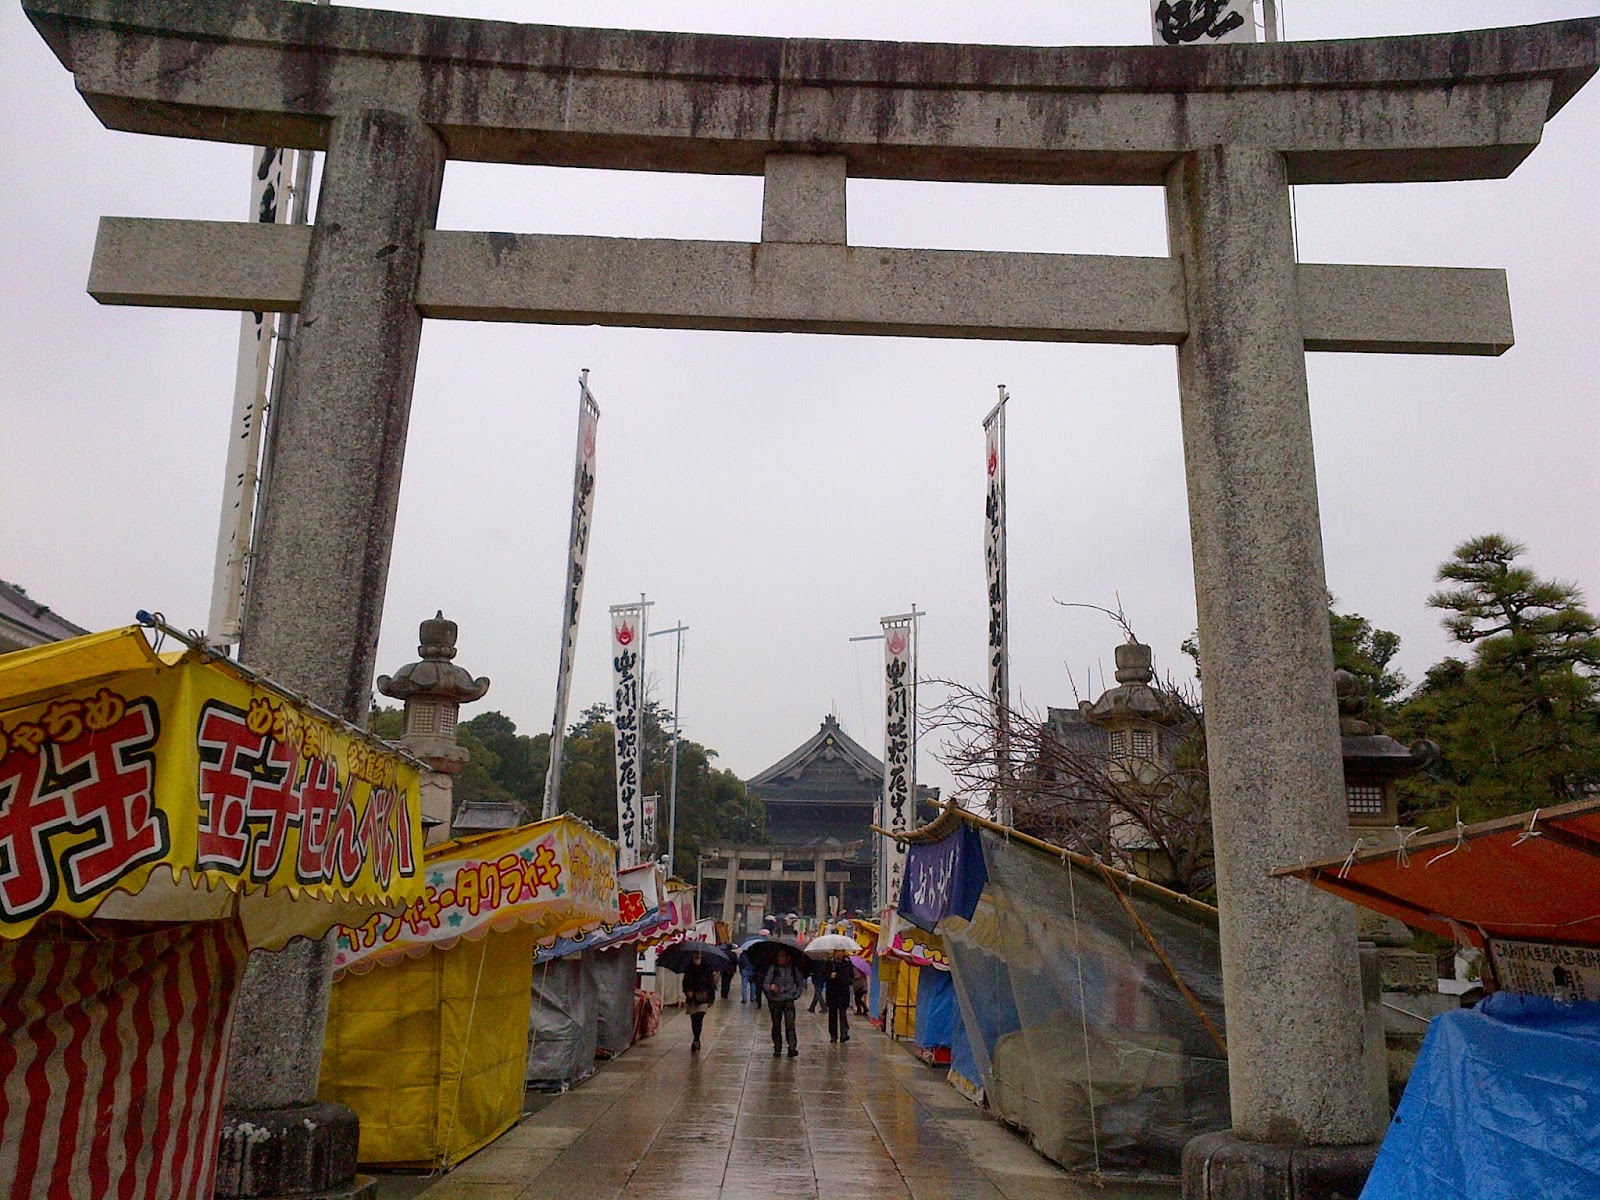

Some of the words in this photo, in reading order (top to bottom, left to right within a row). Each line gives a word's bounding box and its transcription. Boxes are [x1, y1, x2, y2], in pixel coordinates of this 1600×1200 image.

[199, 698, 415, 892] 玉子せんべい
